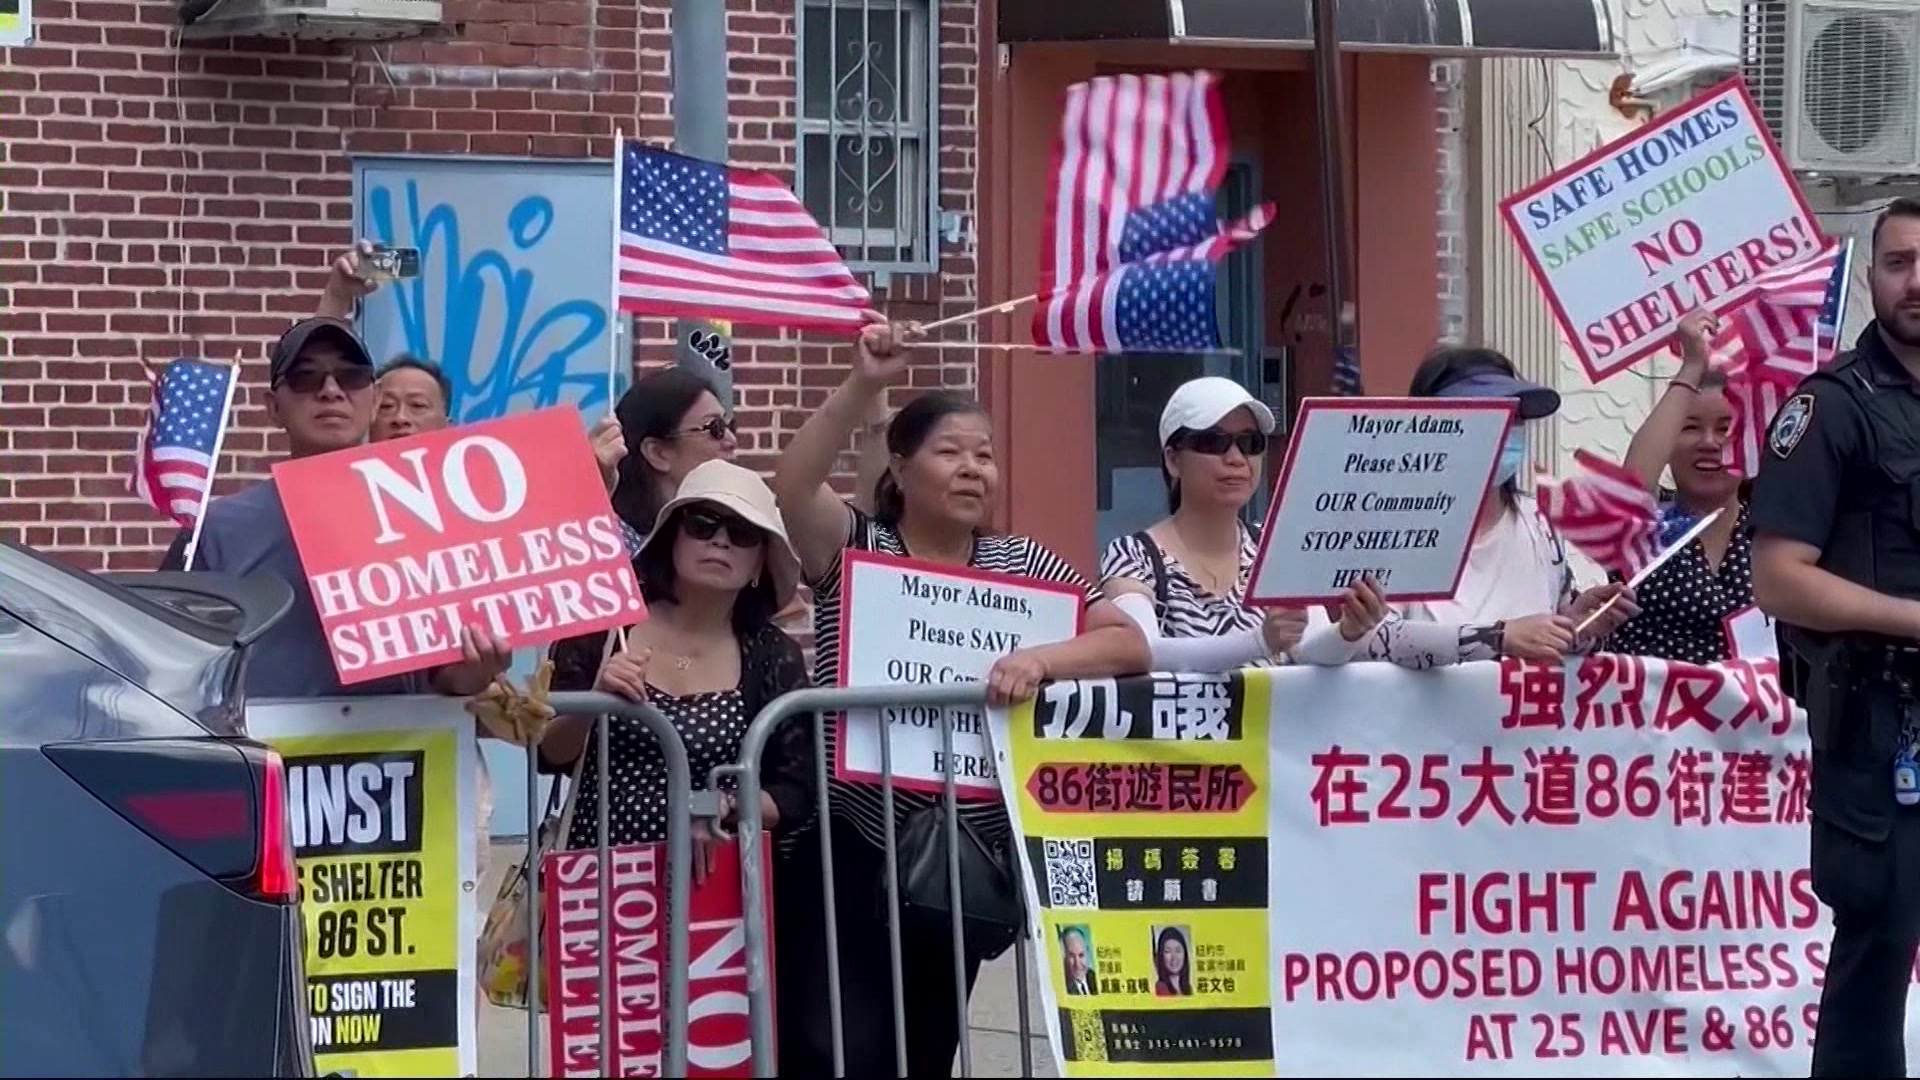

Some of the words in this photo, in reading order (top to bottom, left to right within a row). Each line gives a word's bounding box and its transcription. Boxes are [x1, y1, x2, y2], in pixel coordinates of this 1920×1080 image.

[1527, 166, 1614, 230] SAFE
[1613, 99, 1740, 183] HOMES
[1542, 211, 1622, 270] SAFE
[1621, 134, 1766, 228] SCHOOLS
[1632, 219, 1704, 278] NO
[1586, 216, 1813, 359] SHELTERS!
[1347, 415, 1402, 439] Mayor
[1405, 415, 1465, 437] Adams,
[350, 435, 527, 544] NO
[1344, 453, 1395, 473] Please
[1398, 452, 1447, 473] SAVE
[1315, 493, 1356, 512] OUR
[1362, 491, 1456, 515] Community
[311, 515, 622, 617] HOMELESS
[1301, 531, 1352, 551] STOP
[1353, 529, 1439, 550] SHELTER
[331, 568, 641, 671] SHELTERS!
[901, 574, 962, 606] Mayor
[966, 586, 1033, 619] Adams,
[909, 618, 965, 646] Please
[887, 659, 932, 684] OUR
[312, 859, 423, 904] SHELTER
[1418, 871, 1597, 935] FIGHT
[1613, 867, 1819, 934] AGAINS
[318, 909, 358, 959] 86
[367, 907, 416, 956] ST.
[557, 854, 600, 1078] SHELTE
[687, 919, 752, 1070] NO
[1284, 949, 1543, 1002] PROPOSED
[1556, 942, 1799, 995] HOMELESS
[331, 981, 377, 1012] SIGN
[381, 979, 416, 1009] THE
[336, 1013, 381, 1044] NOW
[1465, 1014, 1518, 1061] AT
[1533, 1013, 1585, 1059] 25
[1600, 1007, 1688, 1056] AVE
[1702, 1005, 1736, 1051] &
[1745, 1004, 1794, 1049] 86
